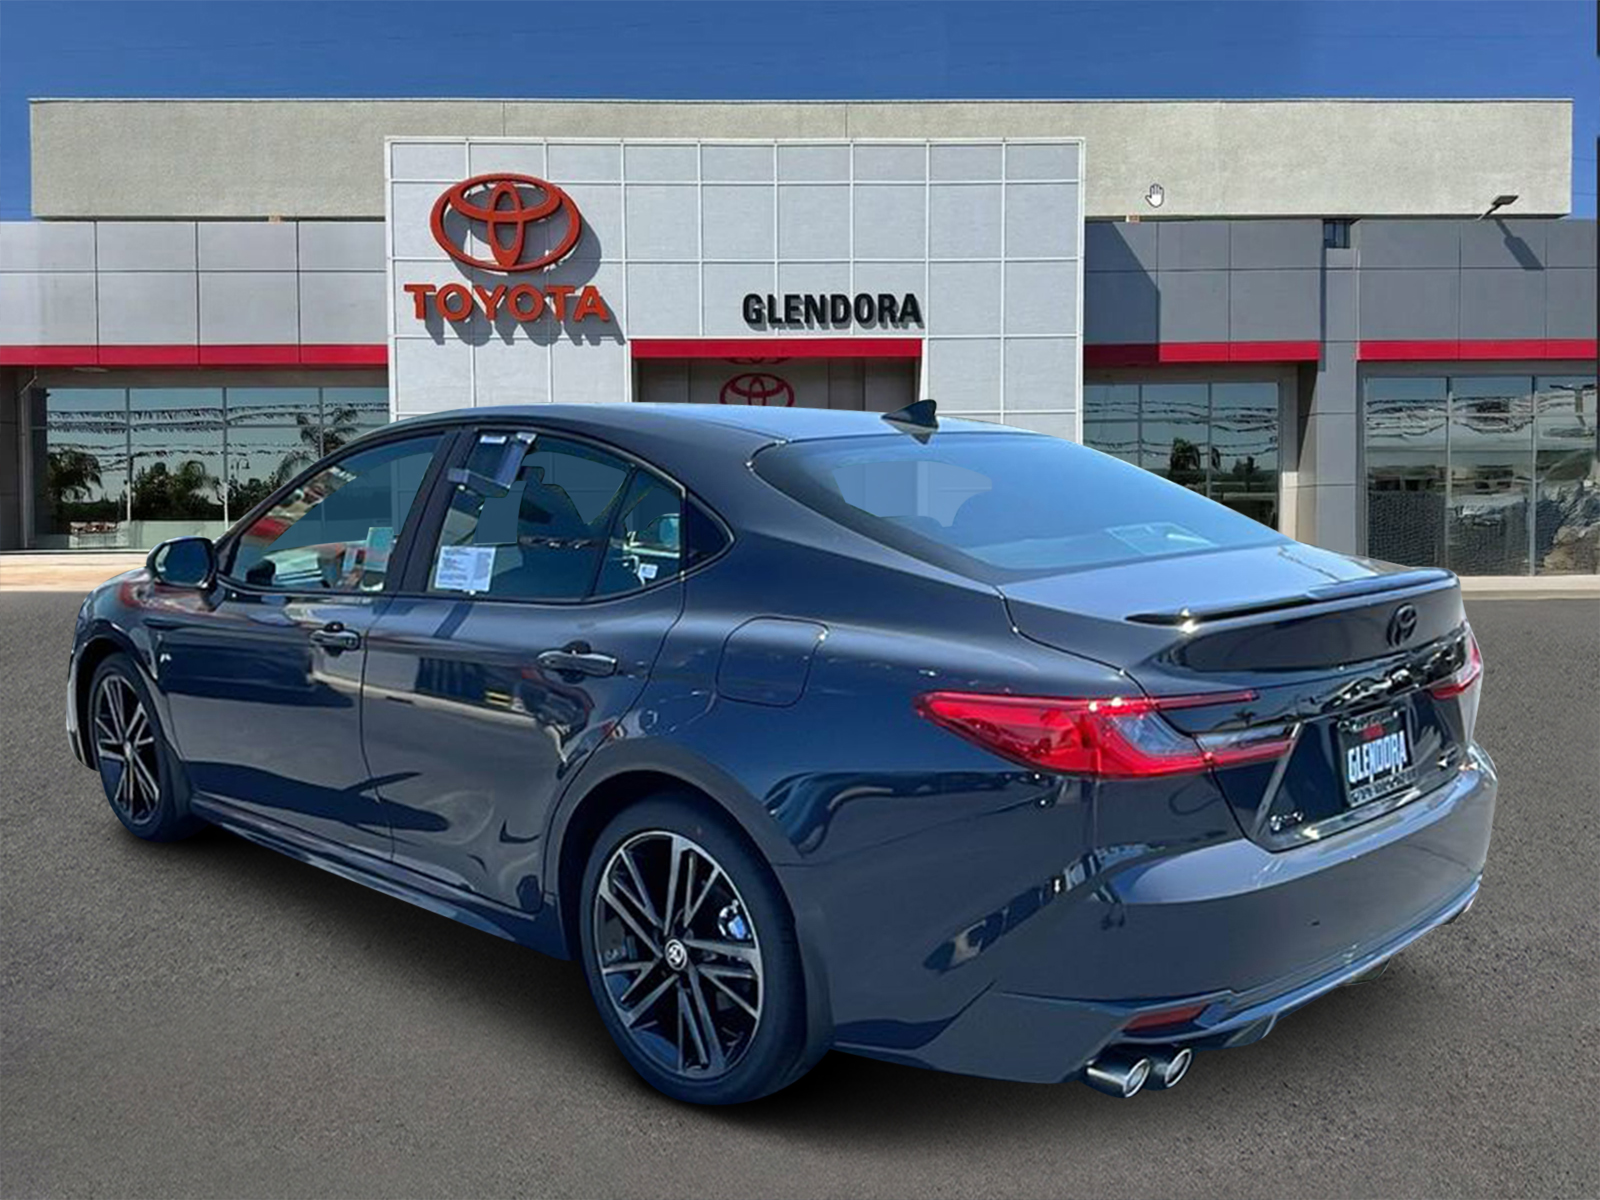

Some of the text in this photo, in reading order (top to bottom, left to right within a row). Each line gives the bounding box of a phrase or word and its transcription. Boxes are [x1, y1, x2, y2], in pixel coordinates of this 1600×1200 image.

[404, 284, 609, 322] TOYOTA
[742, 293, 922, 324] GLENDORA
[1347, 730, 1407, 783] GLENDORA
